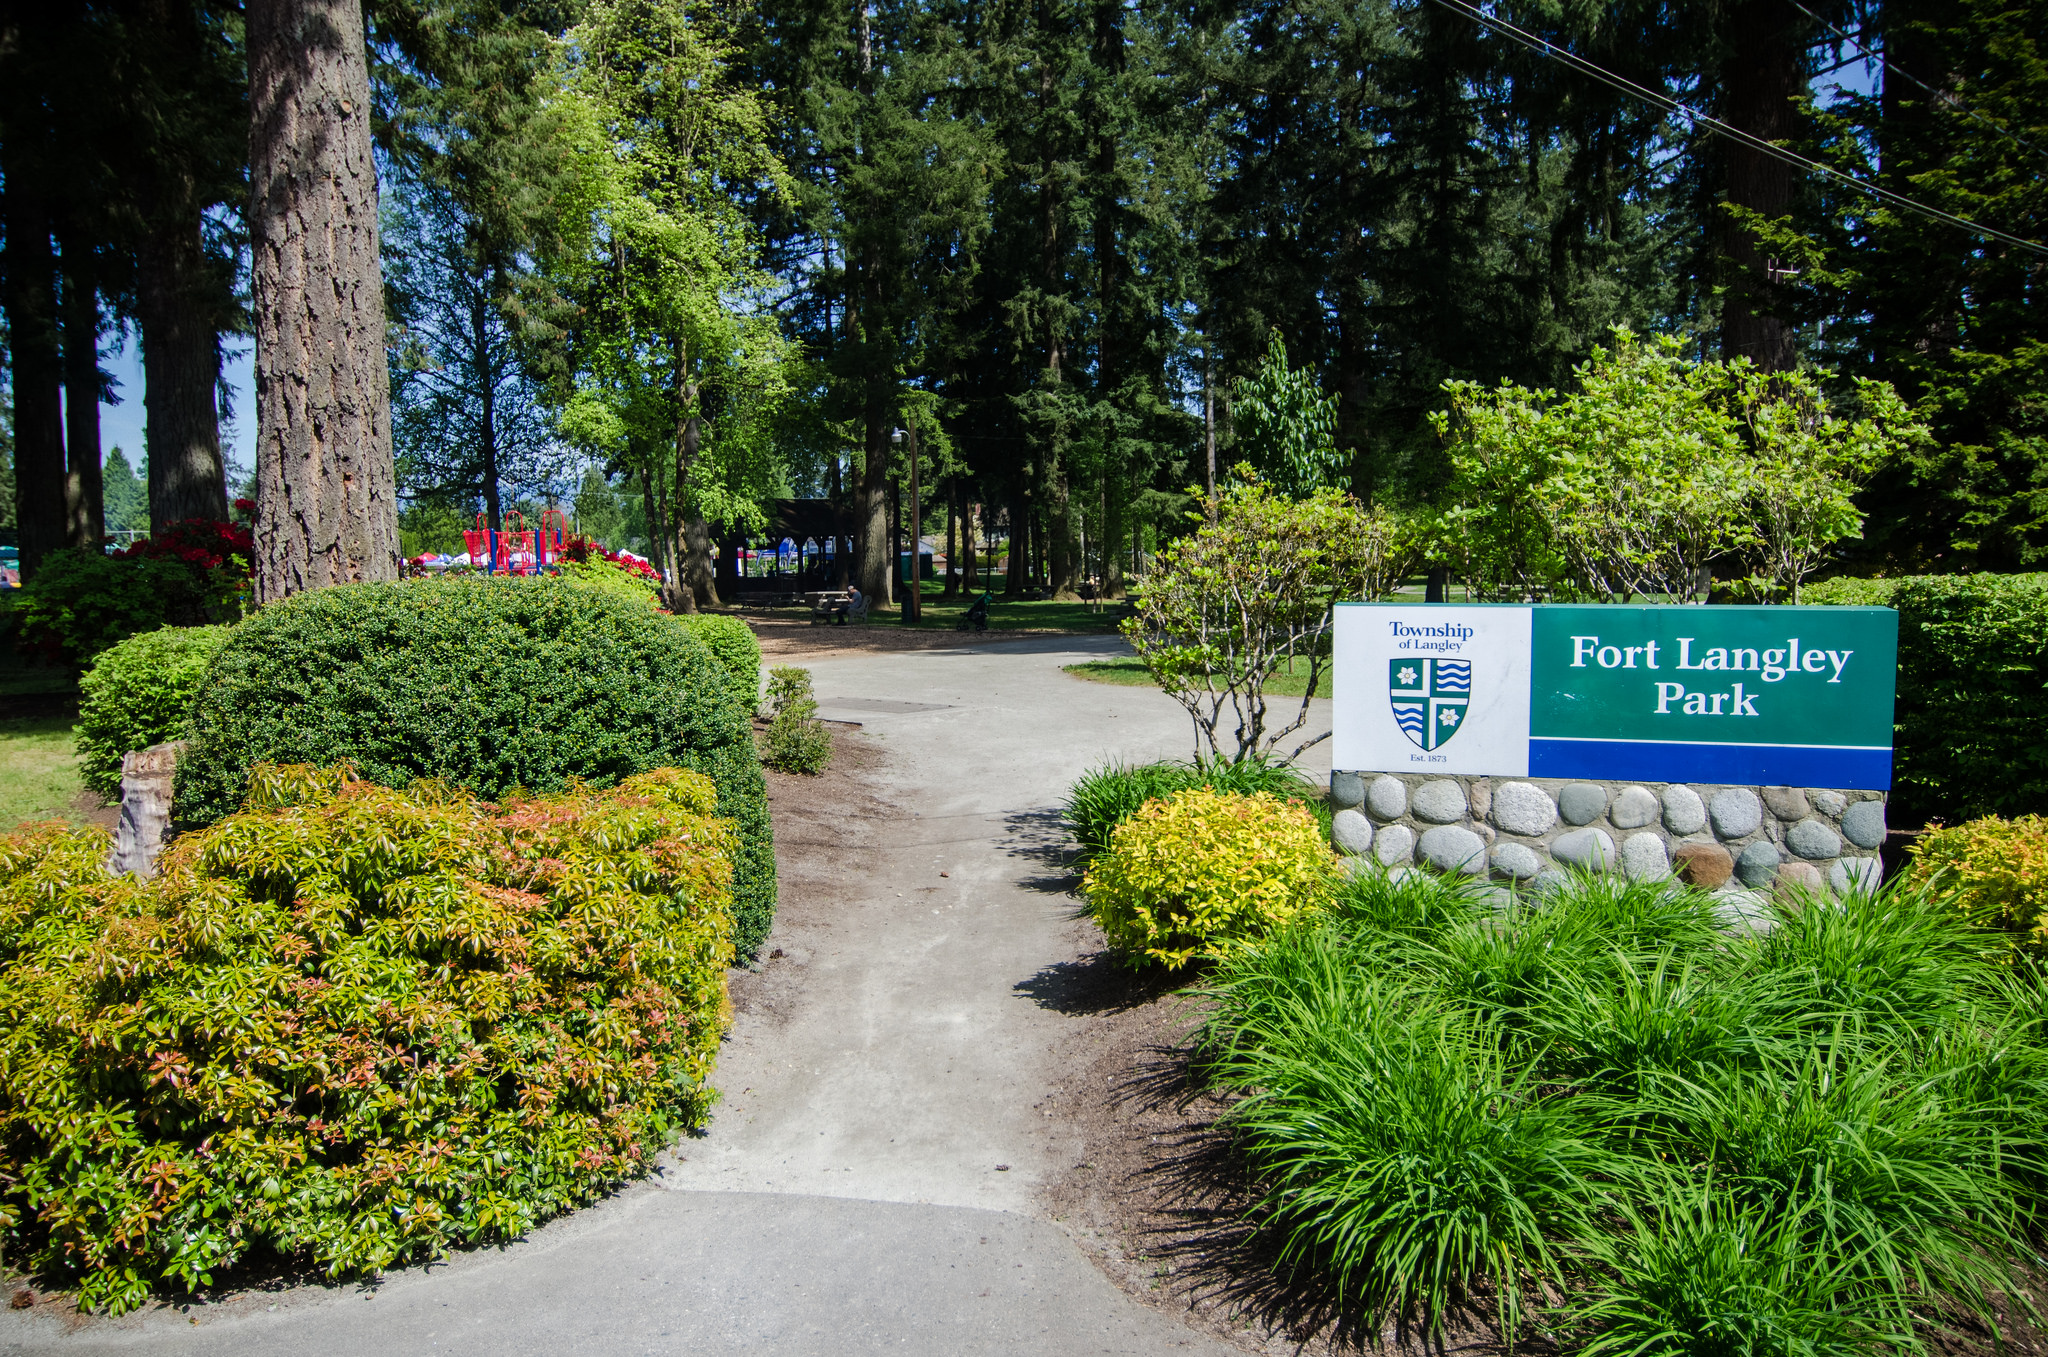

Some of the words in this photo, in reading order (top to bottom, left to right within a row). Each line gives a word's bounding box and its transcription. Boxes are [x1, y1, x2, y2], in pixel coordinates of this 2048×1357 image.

[1389, 622, 1473, 642] Township
[1399, 639, 1412, 650] of
[1414, 639, 1463, 653] Langley
[1570, 636, 1661, 670] Fort
[1676, 638, 1854, 683] Langley
[1654, 682, 1760, 717] Park
[1410, 753, 1426, 762] Est.
[1428, 755, 1447, 763] 1873
